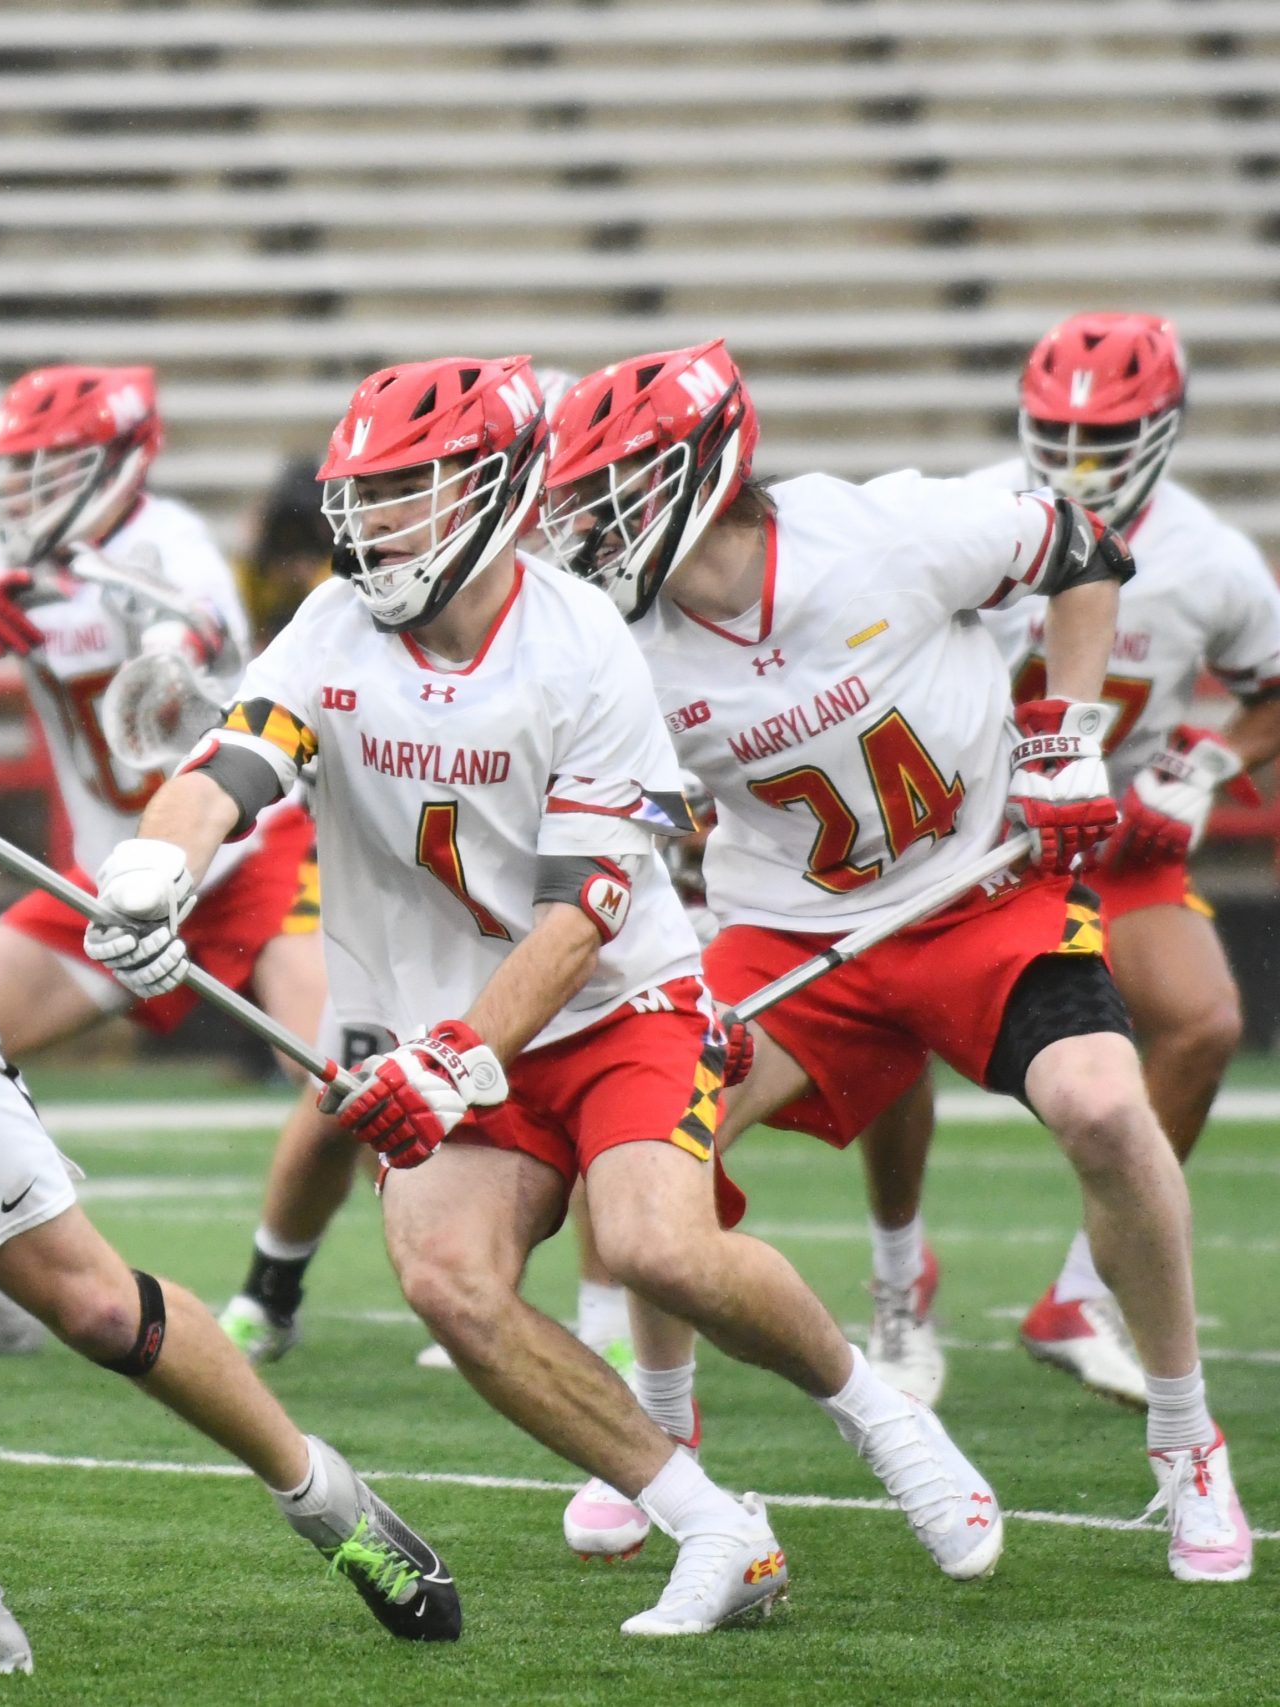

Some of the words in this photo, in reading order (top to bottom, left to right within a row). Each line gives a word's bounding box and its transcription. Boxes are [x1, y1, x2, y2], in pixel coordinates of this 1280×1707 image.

[360, 731, 511, 785] MARYLAND
[727, 675, 870, 765] MARYLAND
[747, 704, 966, 894] 24
[416, 800, 513, 942] 1
[598, 882, 624, 917] M
